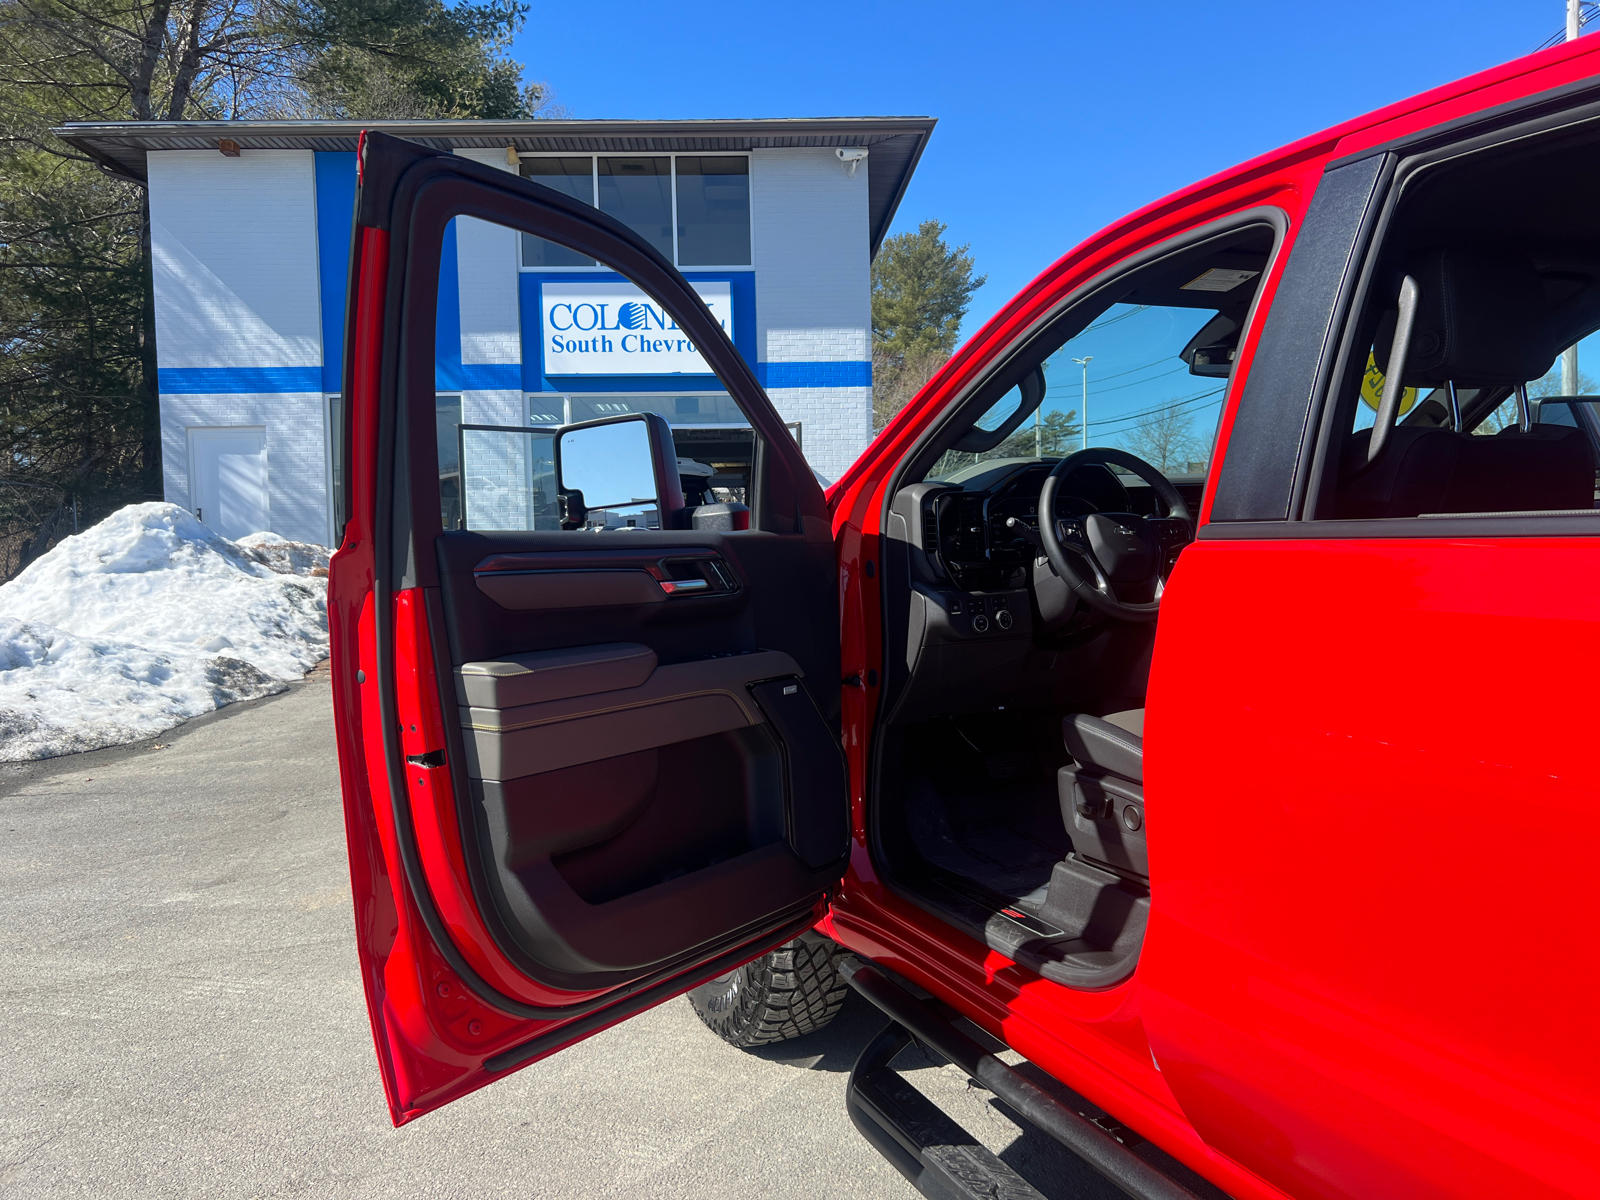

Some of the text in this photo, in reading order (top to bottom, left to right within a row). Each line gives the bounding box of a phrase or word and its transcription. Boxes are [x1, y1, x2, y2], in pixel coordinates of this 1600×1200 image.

[550, 302, 725, 331] COLON
[552, 334, 699, 353] South Chevro
